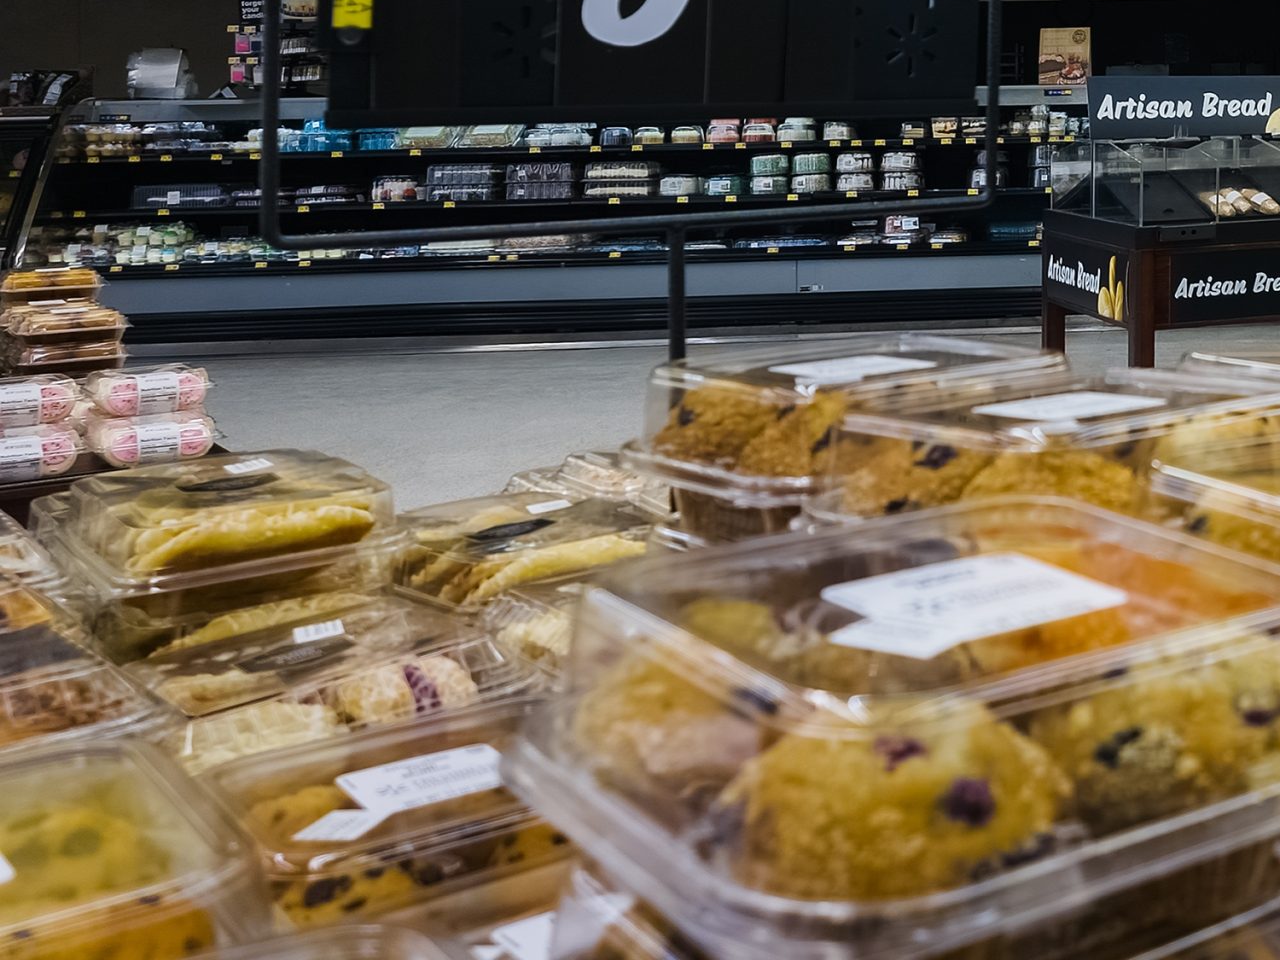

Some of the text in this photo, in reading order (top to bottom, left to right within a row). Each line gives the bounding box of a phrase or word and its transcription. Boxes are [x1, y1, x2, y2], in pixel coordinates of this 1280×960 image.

[1096, 91, 1273, 120] Artisan Bread
[1047, 254, 1101, 294] Artisan Bread
[1174, 275, 1247, 299] Artisan
